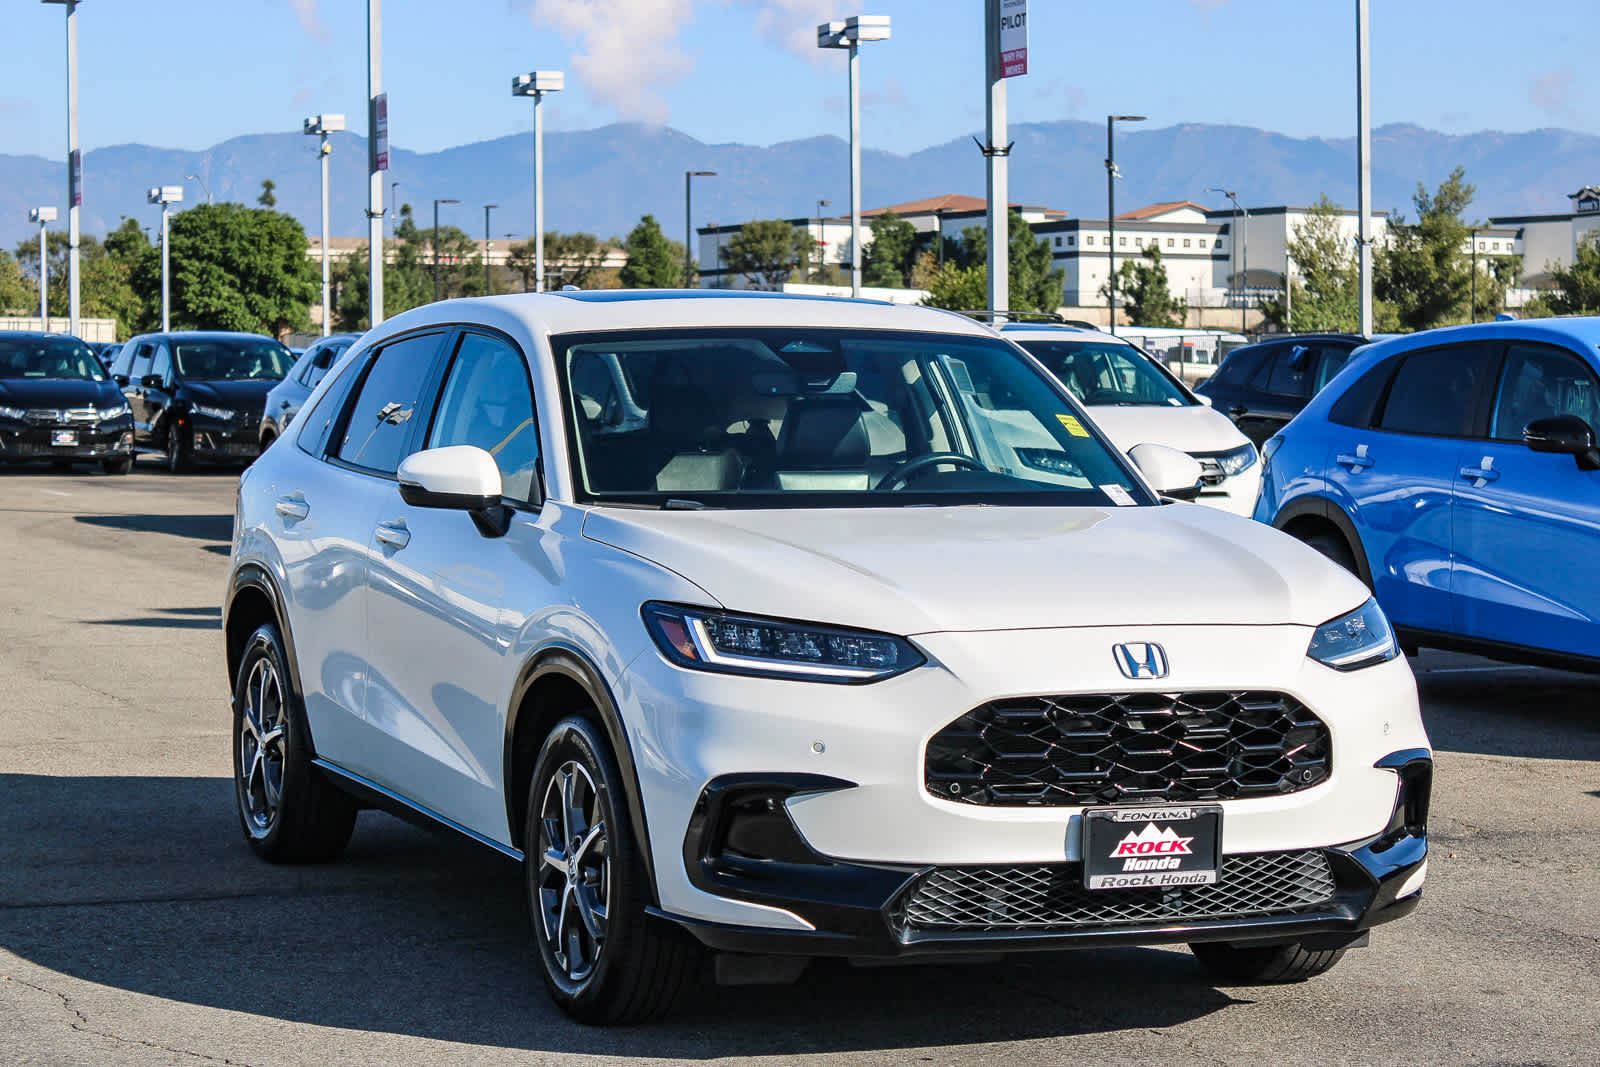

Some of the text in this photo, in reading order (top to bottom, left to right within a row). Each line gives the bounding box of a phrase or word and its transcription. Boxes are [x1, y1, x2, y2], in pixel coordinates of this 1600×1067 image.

[1001, 13, 1026, 30] PILOT
[1121, 811, 1189, 820] FONTANA
[1117, 839, 1188, 855] ROCK
[1122, 856, 1182, 872] Honda
[1100, 873, 1207, 888] Rock Honda
